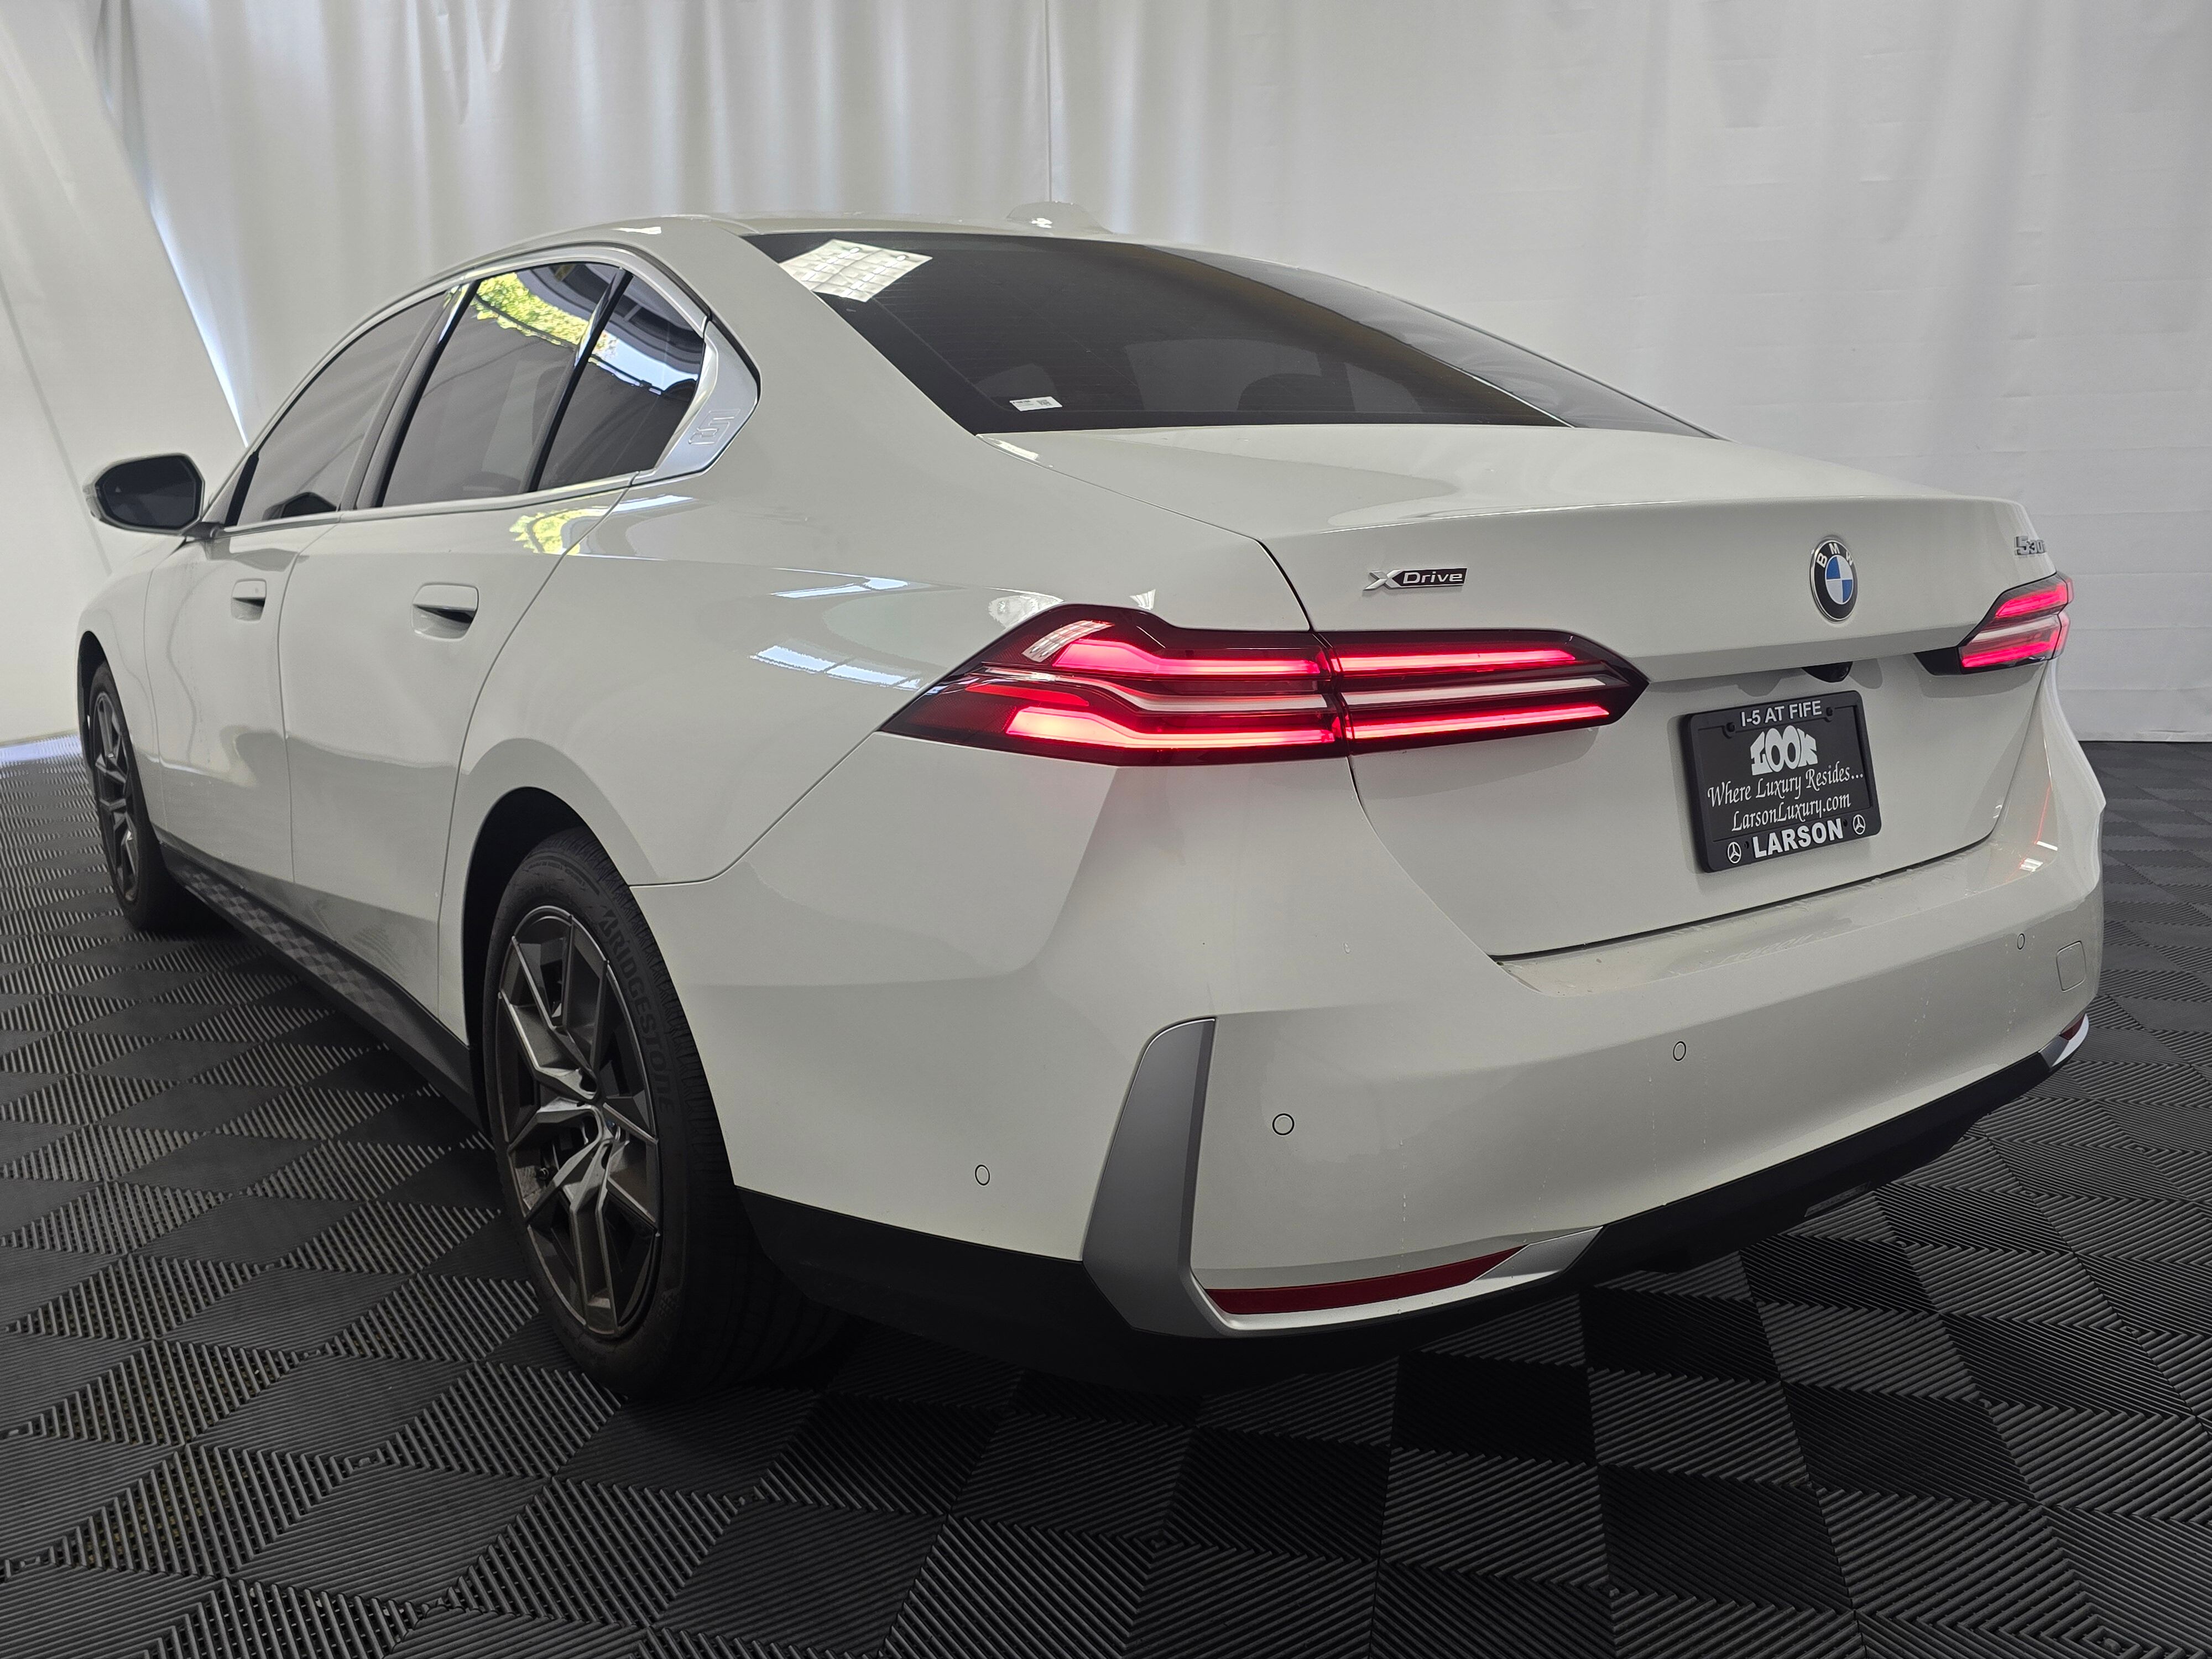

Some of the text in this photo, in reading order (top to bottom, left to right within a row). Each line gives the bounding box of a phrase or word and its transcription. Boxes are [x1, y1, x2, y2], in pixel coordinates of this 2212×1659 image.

[1816, 542, 1853, 568] BMW
[1741, 700, 1822, 727] I-5 AT FIFE
[1750, 725, 1818, 776] LOOK
[1707, 781, 1751, 807] Where
[1756, 774, 1802, 800] Luxury
[1731, 793, 1851, 832] LarsonLuxury.com
[1752, 818, 1843, 859] LARSON
[598, 908, 675, 1114] BRIDGESTONE
